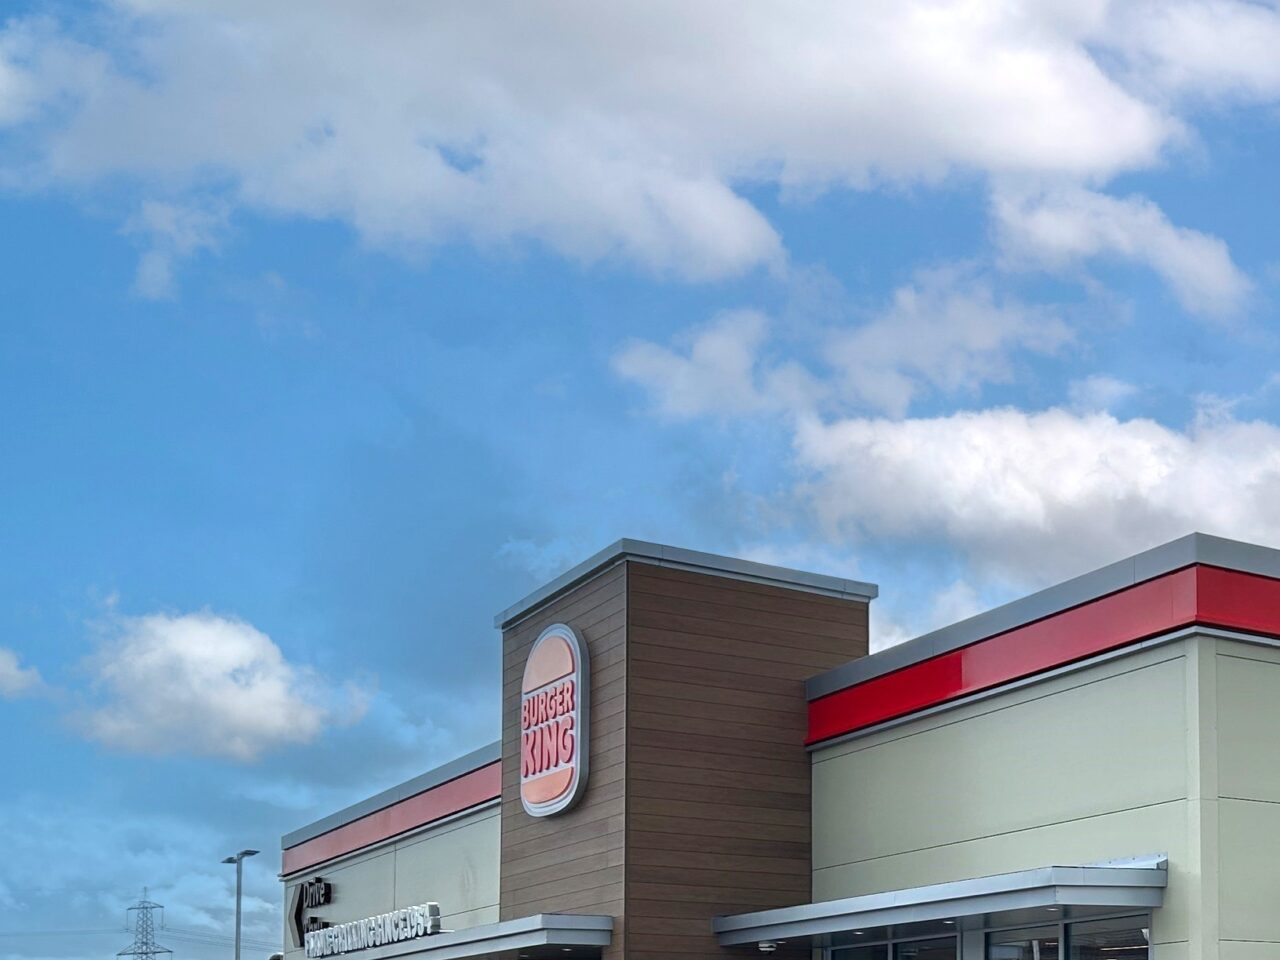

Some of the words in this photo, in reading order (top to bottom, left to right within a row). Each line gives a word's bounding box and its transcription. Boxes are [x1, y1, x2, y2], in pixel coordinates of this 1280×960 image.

[523, 680, 575, 730] BURGER
[523, 716, 575, 778] KING
[303, 880, 326, 908] Drive
